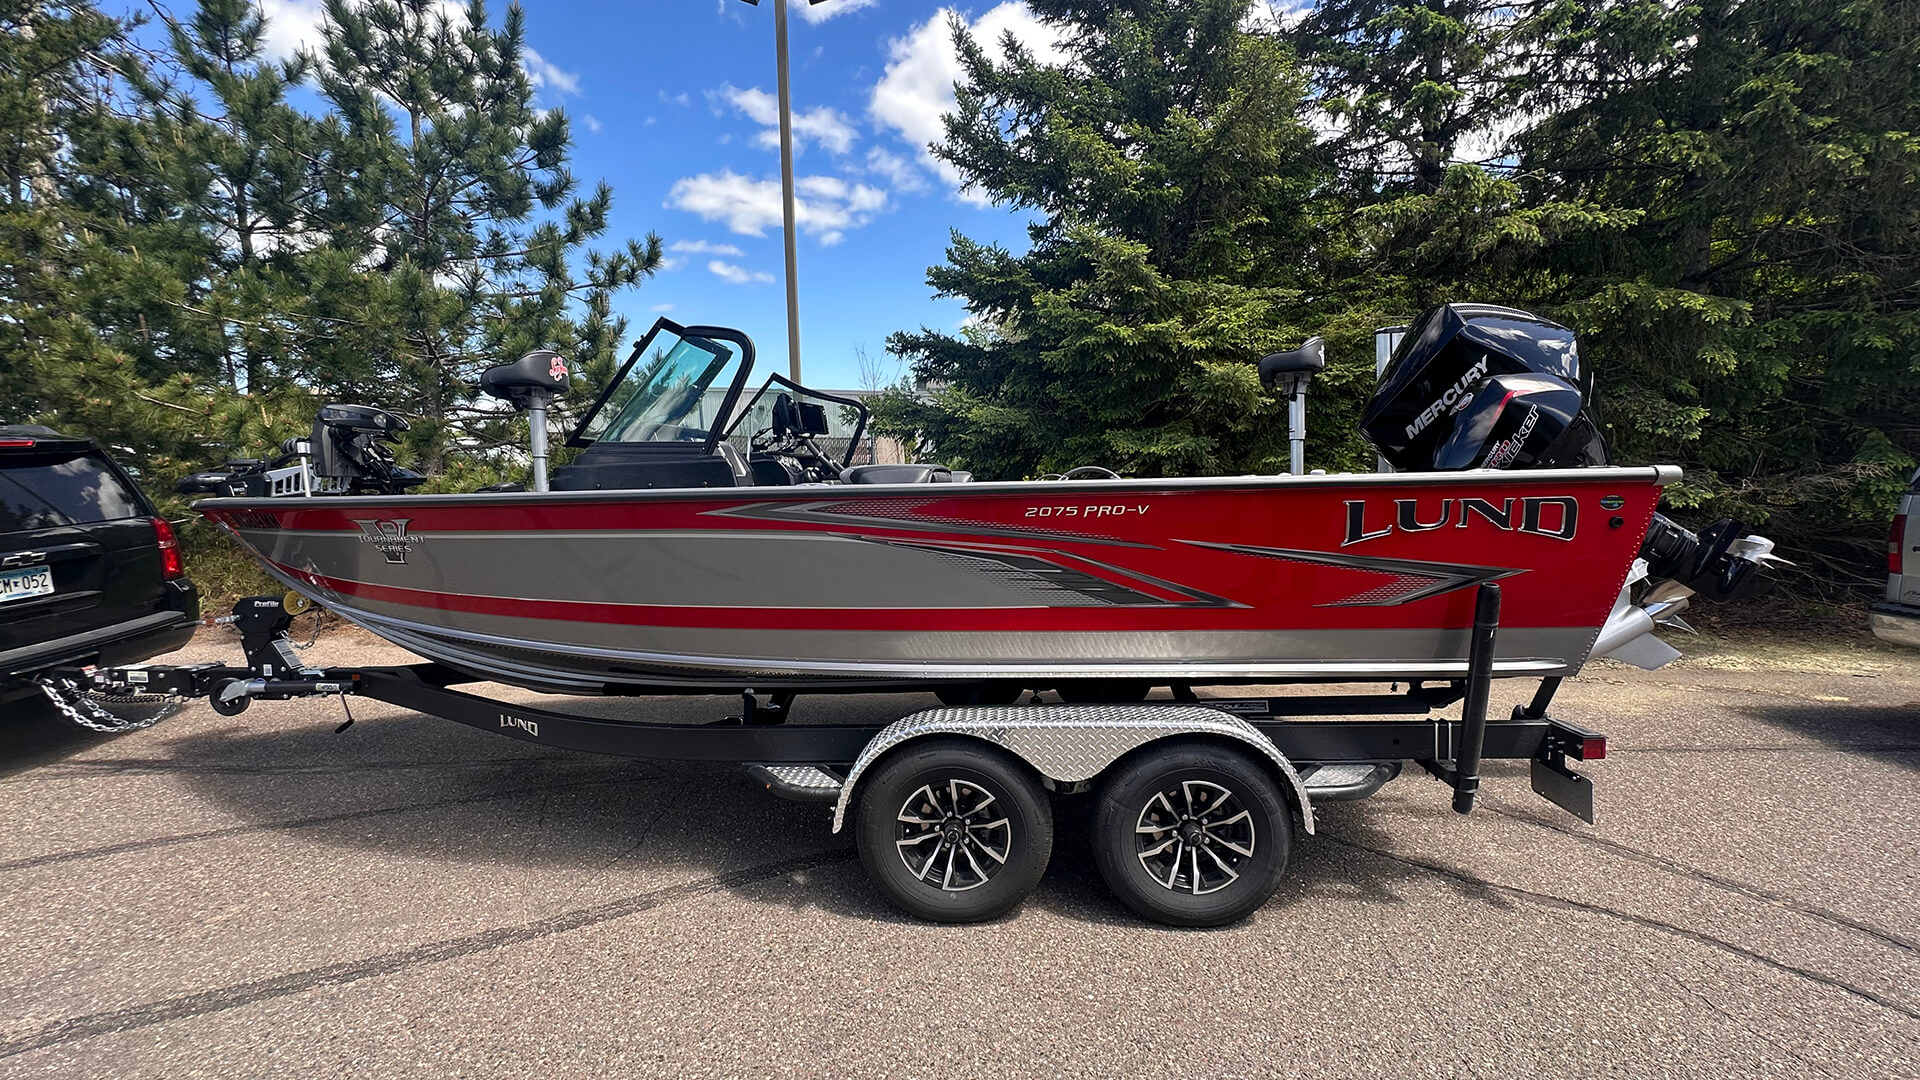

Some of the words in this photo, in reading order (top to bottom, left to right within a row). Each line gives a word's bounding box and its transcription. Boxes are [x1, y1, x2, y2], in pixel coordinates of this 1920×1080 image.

[1405, 354, 1488, 440] MERCURY
[1025, 506, 1079, 518] 2075
[1083, 504, 1150, 518] PRO-V
[1340, 495, 1579, 548] LUND
[358, 534, 425, 544] TOURNAMENT
[375, 544, 413, 553] SERIES
[254, 600, 280, 608] Profile
[500, 714, 539, 737] LUND
